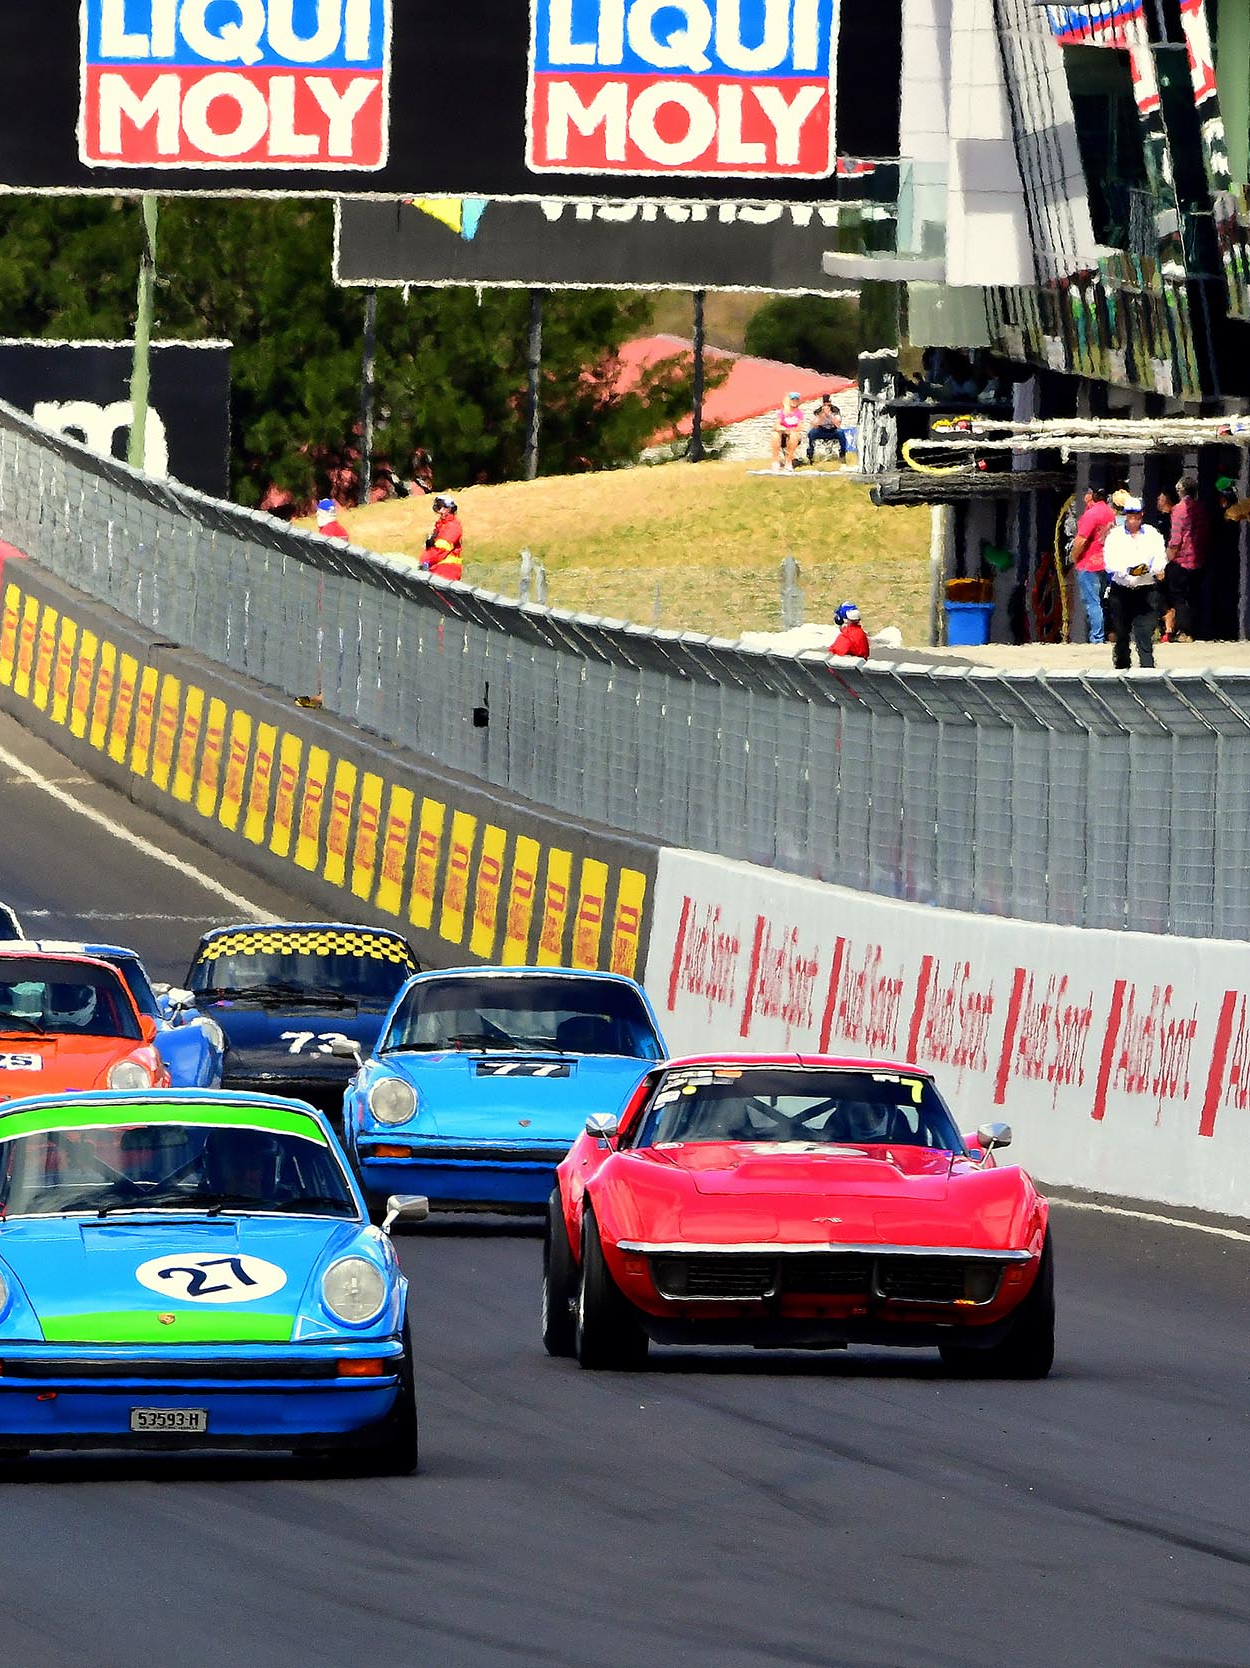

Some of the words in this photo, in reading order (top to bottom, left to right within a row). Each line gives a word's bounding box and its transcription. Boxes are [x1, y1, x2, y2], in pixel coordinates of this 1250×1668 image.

[100, 0, 372, 66] LIQUI
[548, 0, 821, 73] LIQUI
[98, 72, 381, 158] MOLY
[546, 80, 826, 167] MOLY
[484, 1062, 562, 1076] 77
[157, 1257, 258, 1297] 27
